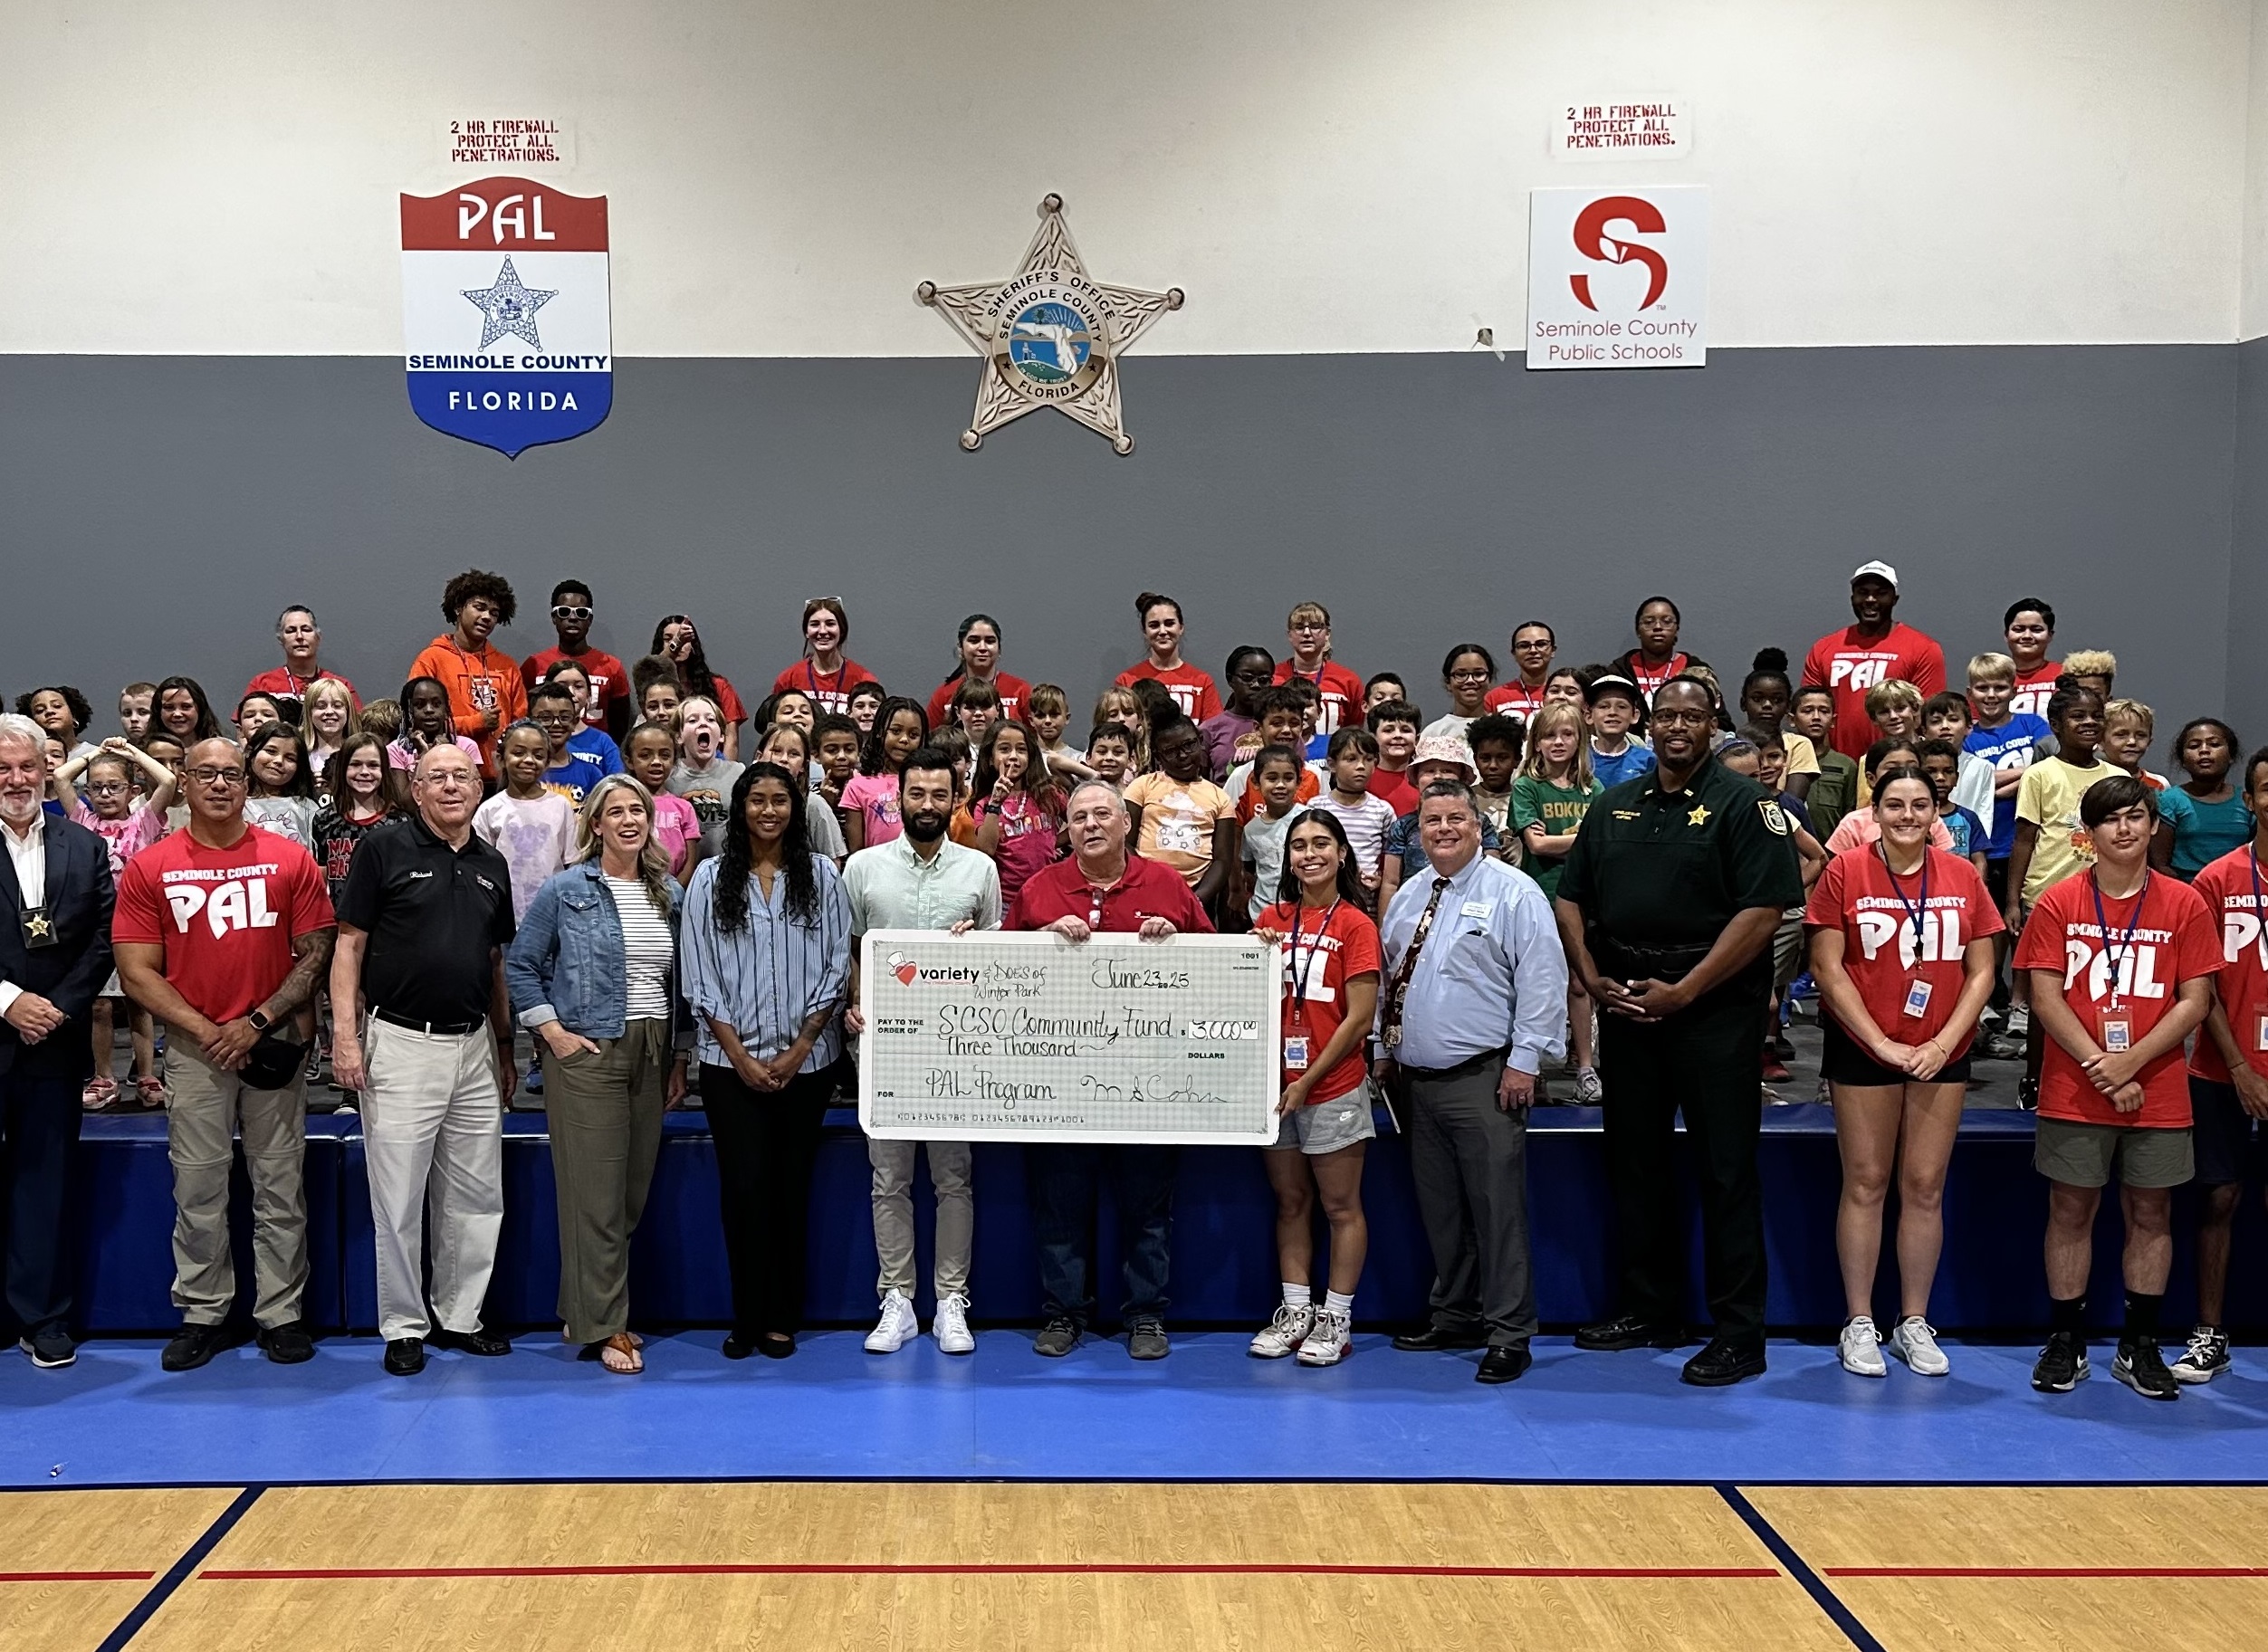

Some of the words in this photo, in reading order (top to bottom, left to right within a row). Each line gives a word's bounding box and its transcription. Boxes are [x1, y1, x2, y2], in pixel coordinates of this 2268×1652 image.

[1566, 108, 1576, 119] 2
[1584, 106, 1602, 119] HR
[1610, 104, 1677, 119] FIREWALL
[451, 121, 459, 134] 2
[467, 120, 485, 134] HR
[493, 120, 559, 133] FIREWALL
[1574, 119, 1635, 133] PROTECT
[1643, 119, 1670, 132] ALL
[457, 135, 518, 148] PROTECT
[527, 135, 553, 148] ALL
[1566, 133, 1676, 148] PENETRATIONS.
[451, 148, 560, 162] PENETRATIONS.
[459, 193, 556, 245] PAL
[989, 272, 1059, 318] SHERIFF'S
[1070, 277, 1115, 320] OFFICE
[1000, 289, 1057, 339] SEMINOLE
[1063, 292, 1102, 342] COUNTY
[1536, 320, 1622, 338] Seminole
[1628, 319, 1697, 338] County
[408, 354, 515, 369] SEMINOLE
[522, 355, 608, 369] COUNTY
[1549, 344, 1605, 360] Public
[1612, 344, 1683, 360] Schools
[1019, 380, 1079, 398] FLORIDA
[448, 391, 579, 411] FLORIDA
[162, 869, 225, 883] SEMINOLE
[226, 864, 279, 880] COUNTY
[164, 877, 279, 941] PAL
[1856, 910, 1966, 971] PAL
[920, 967, 980, 984] variety
[1032, 966, 1048, 986] of
[1092, 958, 1143, 988] June
[1170, 972, 1190, 988] 25
[2063, 939, 2165, 1002] PAL
[1013, 983, 1041, 998] Park
[1012, 1007, 1118, 1045] Community
[1123, 1006, 1173, 1037] Fund
[937, 1034, 992, 1055] Three
[996, 1035, 1078, 1057] Thousand
[924, 1067, 971, 1097] PAL
[973, 1065, 1057, 1110] Program
